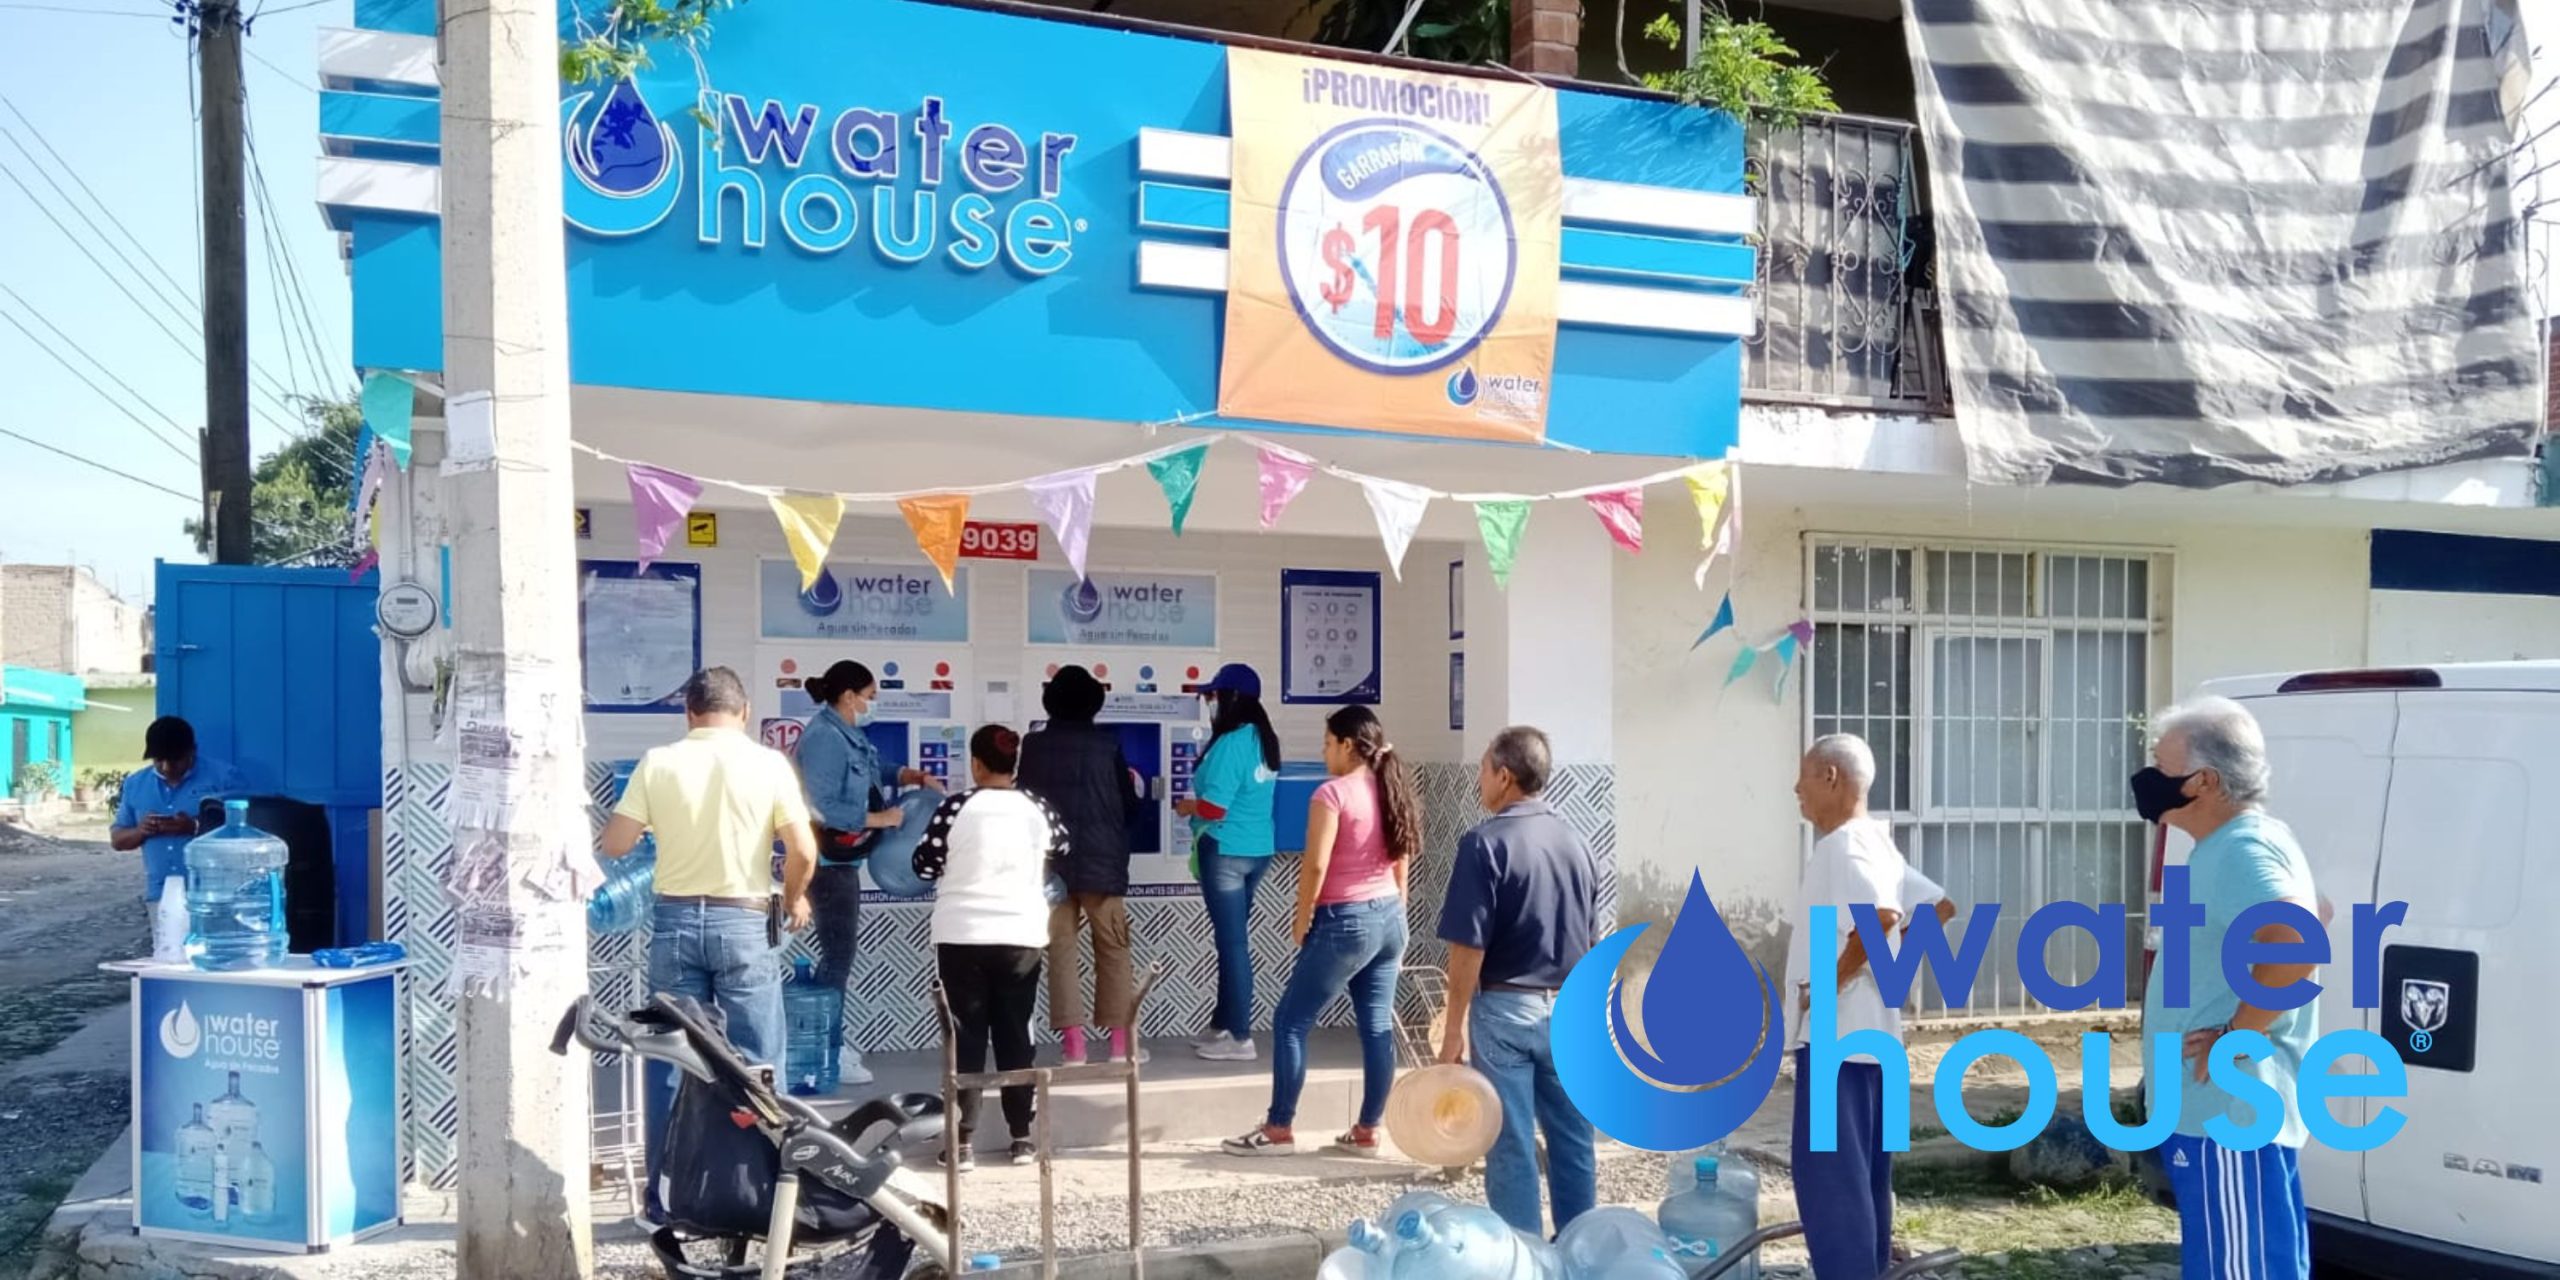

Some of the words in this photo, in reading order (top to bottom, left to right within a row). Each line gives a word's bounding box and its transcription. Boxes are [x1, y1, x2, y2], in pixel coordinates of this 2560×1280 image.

[1302, 67, 1491, 127] ¡PROMOCIÓN!
[725, 95, 1078, 198] water
[1320, 204, 1460, 345] $10
[1488, 374, 1541, 393] water
[962, 526, 1036, 552] 9039
[849, 578, 934, 617] house
[854, 574, 932, 595] water
[1113, 582, 1183, 603] water
[1107, 586, 1186, 624] house
[204, 1015, 281, 1060] house
[210, 1012, 280, 1037] water
